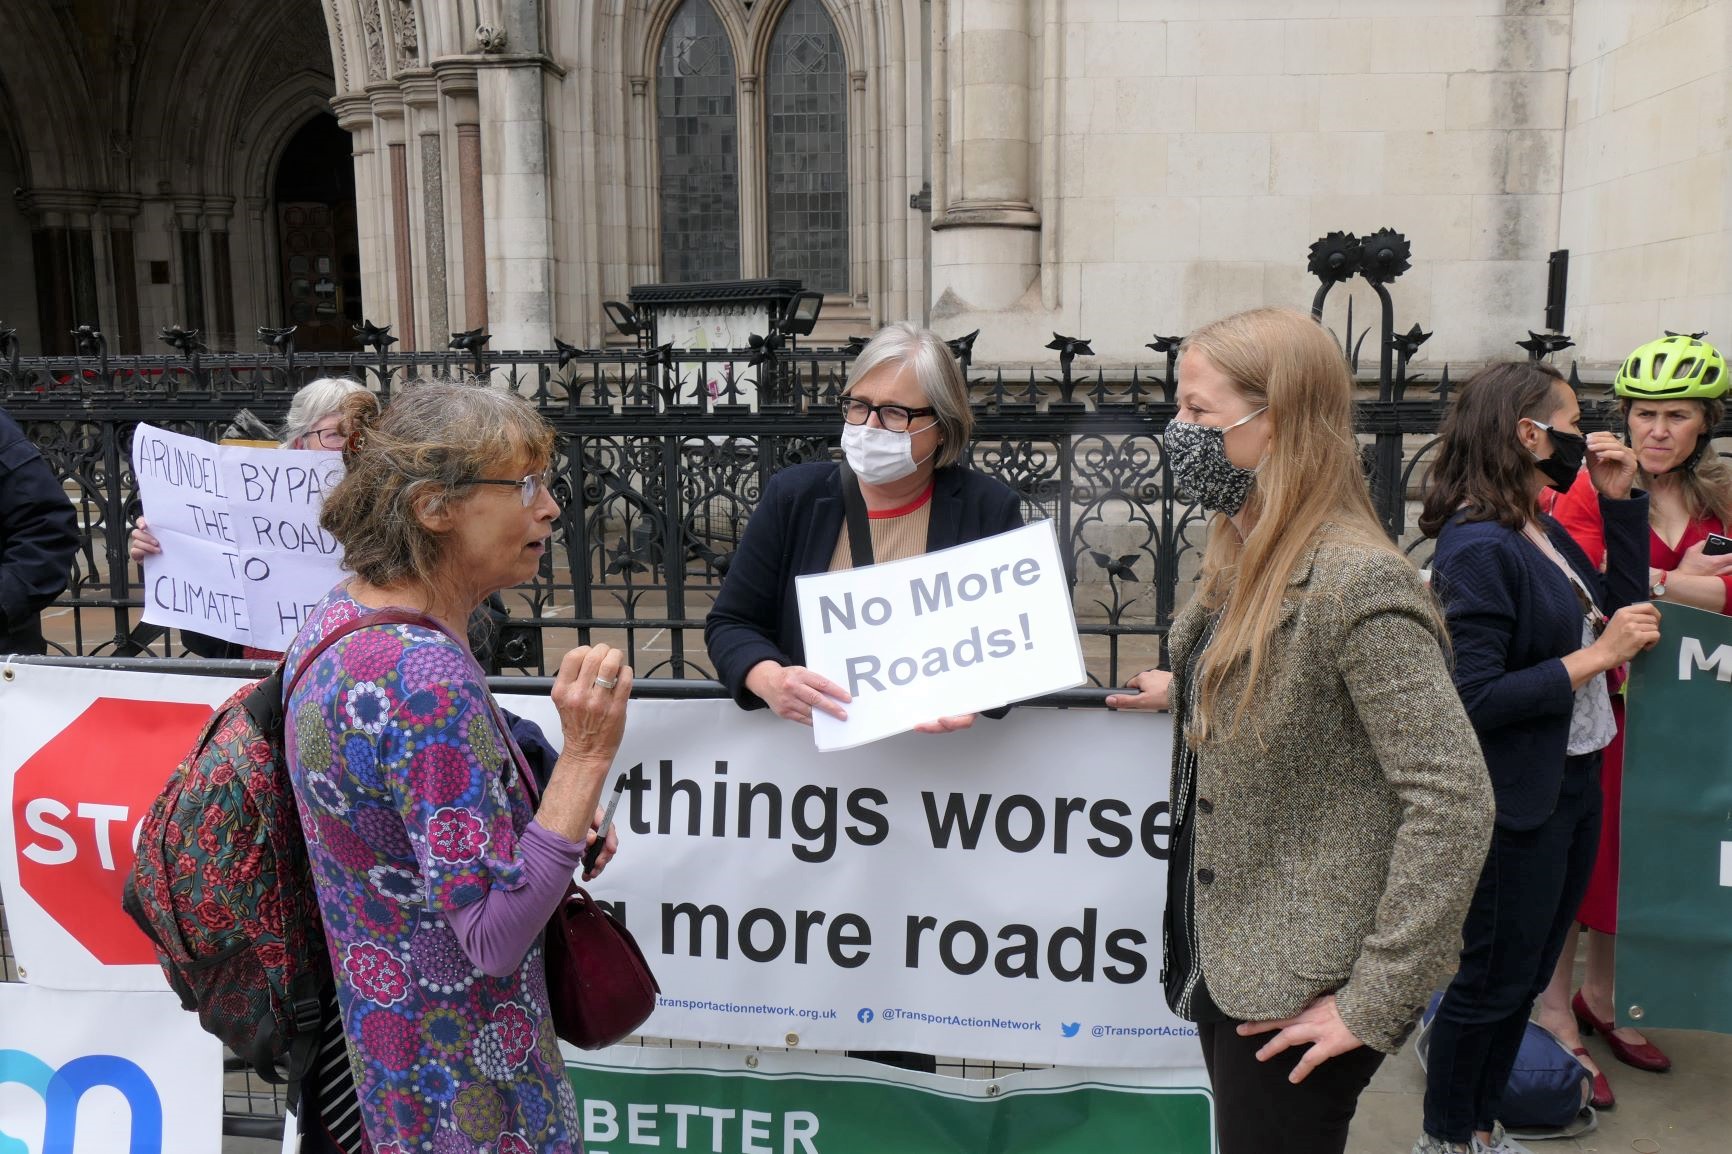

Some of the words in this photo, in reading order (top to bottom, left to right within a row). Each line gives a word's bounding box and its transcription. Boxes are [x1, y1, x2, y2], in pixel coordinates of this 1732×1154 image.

[139, 435, 228, 499] ARUNDEL
[186, 503, 236, 543] THE
[252, 516, 338, 554] ROAD
[222, 552, 270, 581] TO
[818, 591, 892, 634] No
[909, 557, 1041, 617] More
[154, 575, 250, 632] CLIMATE
[845, 612, 1034, 698] Roads!
[22, 797, 143, 871] ST
[624, 760, 889, 863] things
[921, 790, 1169, 861] worse
[660, 901, 872, 969] more
[882, 1008, 1042, 1031] @TransportActionNetwork
[583, 1098, 820, 1154] BETTER
